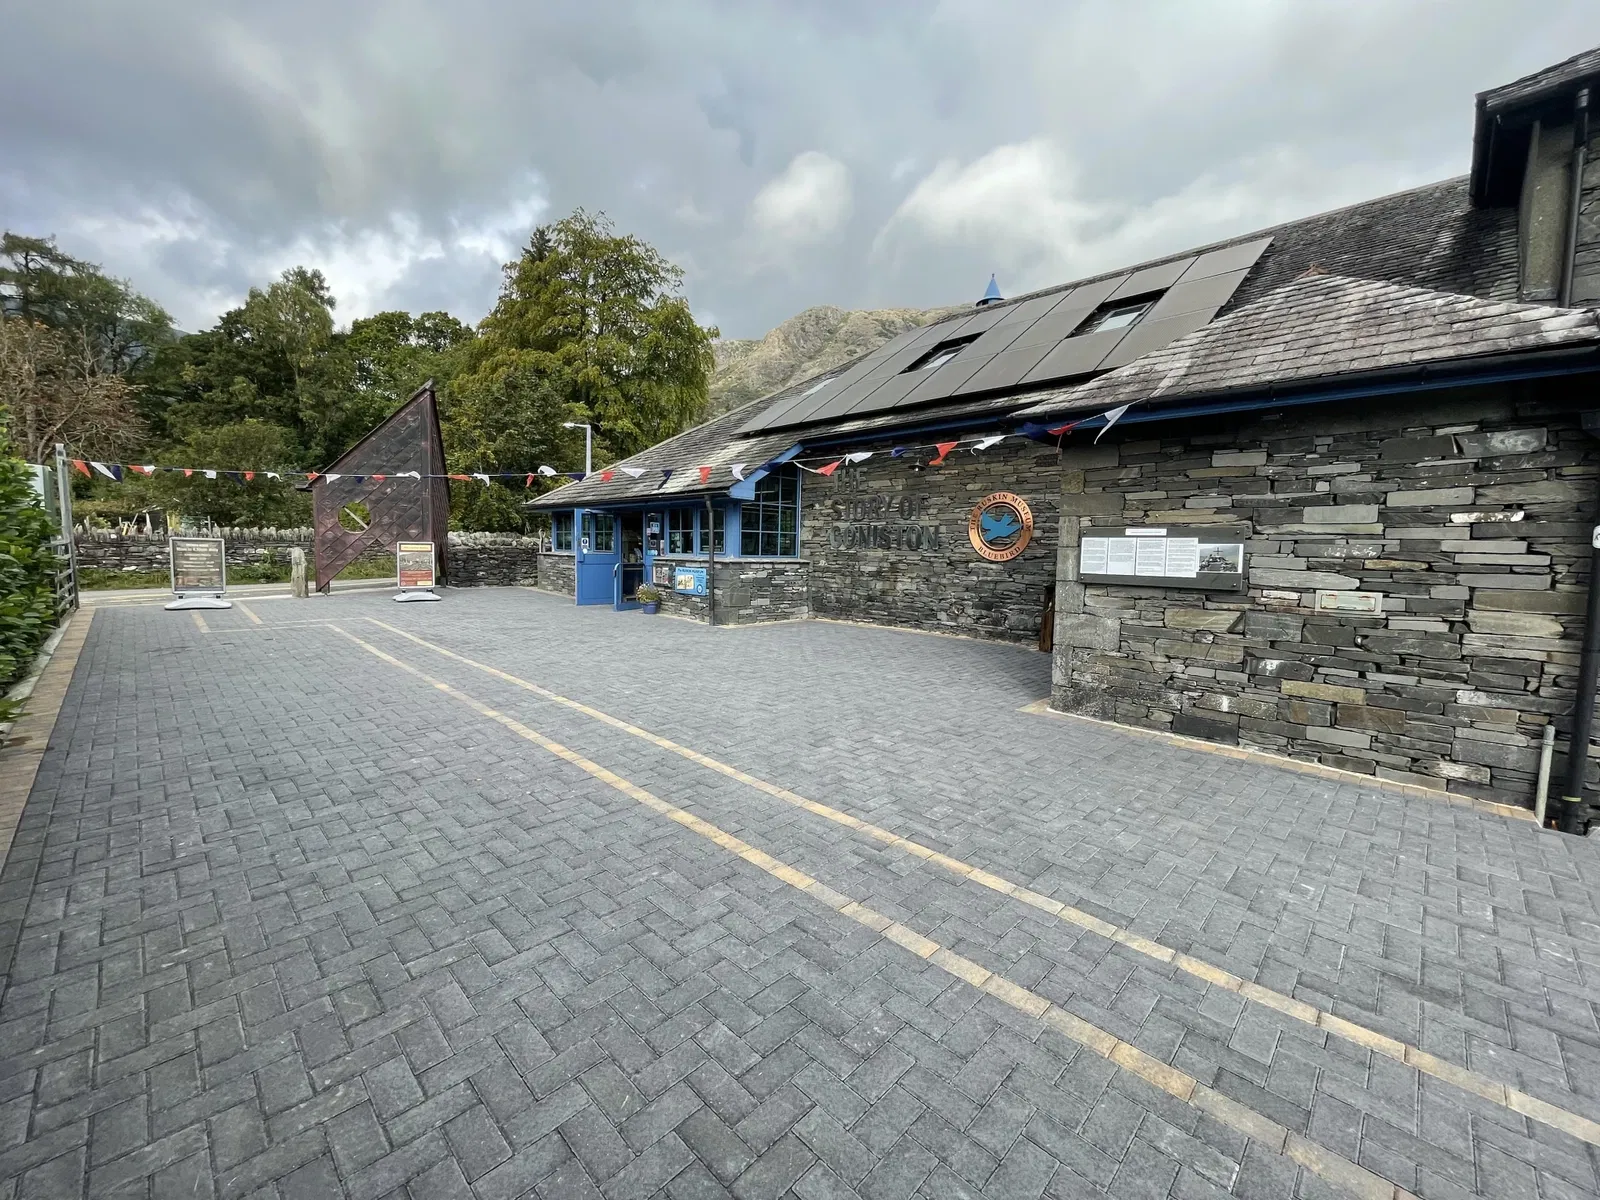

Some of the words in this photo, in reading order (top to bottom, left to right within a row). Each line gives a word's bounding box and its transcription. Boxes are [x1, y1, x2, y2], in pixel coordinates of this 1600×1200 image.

[832, 467, 868, 493] THE
[830, 492, 894, 521] STORY
[899, 492, 930, 520] OF
[970, 512, 979, 531] THE
[976, 493, 1009, 512] RUSKIN
[1010, 495, 1032, 532] MUSEUM
[829, 524, 940, 551] CONISTON
[977, 545, 1021, 561] BLUEBIRD
